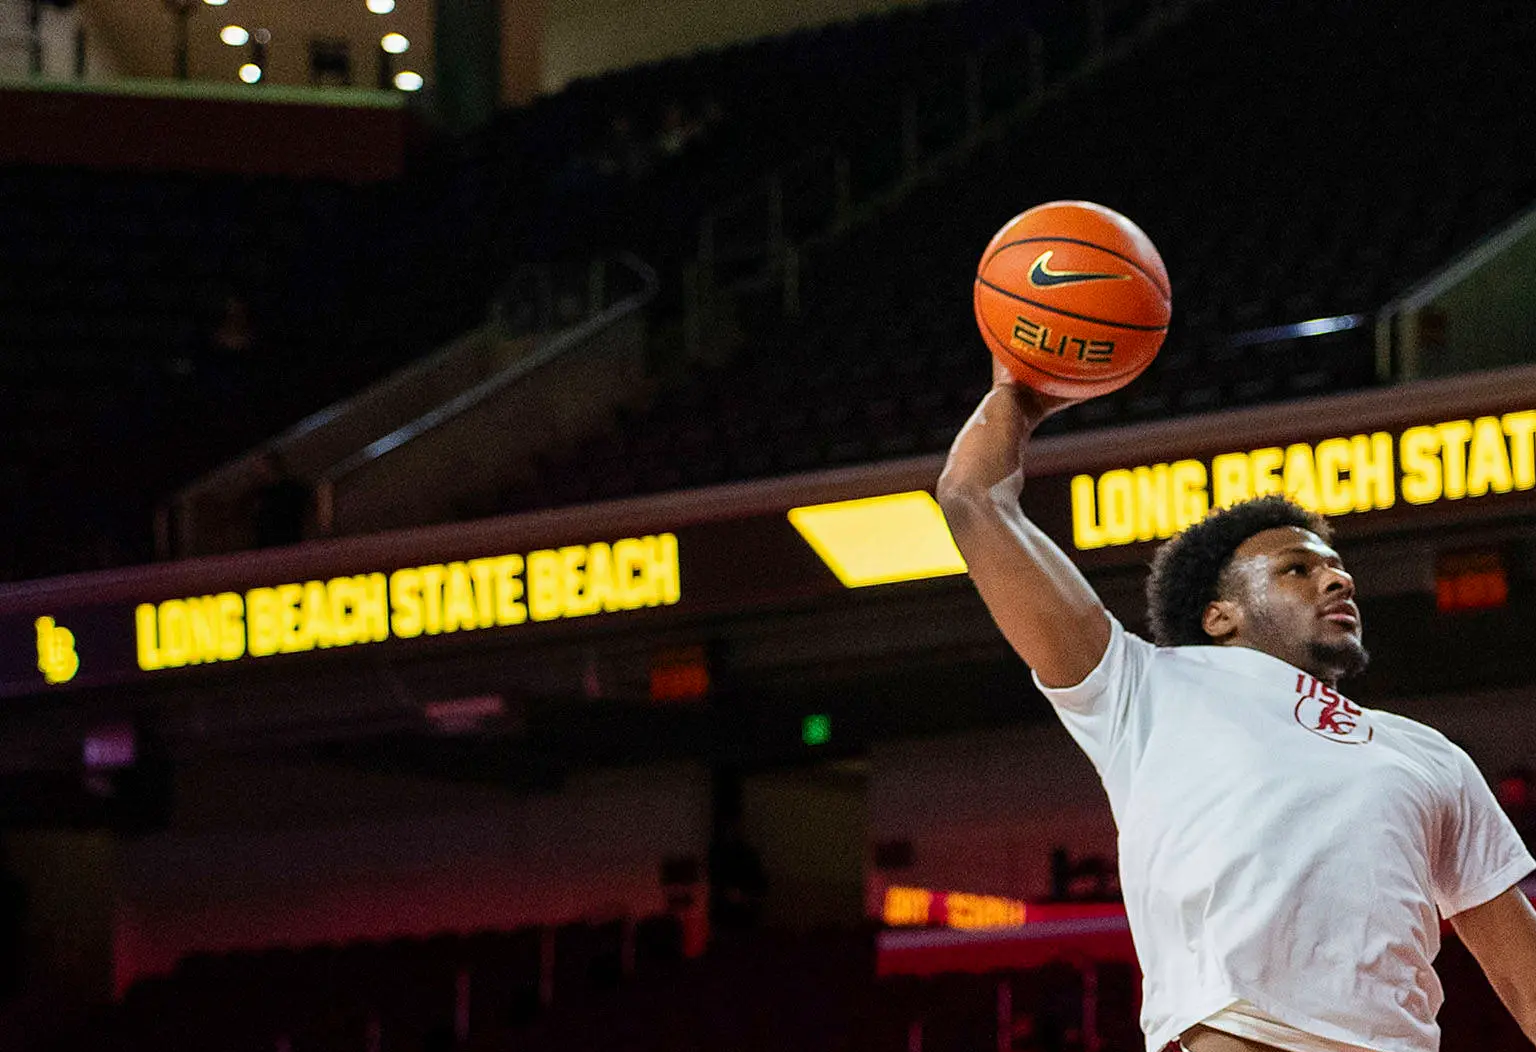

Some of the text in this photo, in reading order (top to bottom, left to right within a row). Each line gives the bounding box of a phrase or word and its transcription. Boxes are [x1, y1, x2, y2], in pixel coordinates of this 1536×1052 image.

[1014, 316, 1115, 362] ELITE
[1071, 459, 1209, 550] LONG
[1212, 432, 1395, 516] BEACH
[135, 533, 680, 671] LONG BEACH STATE BEACH
